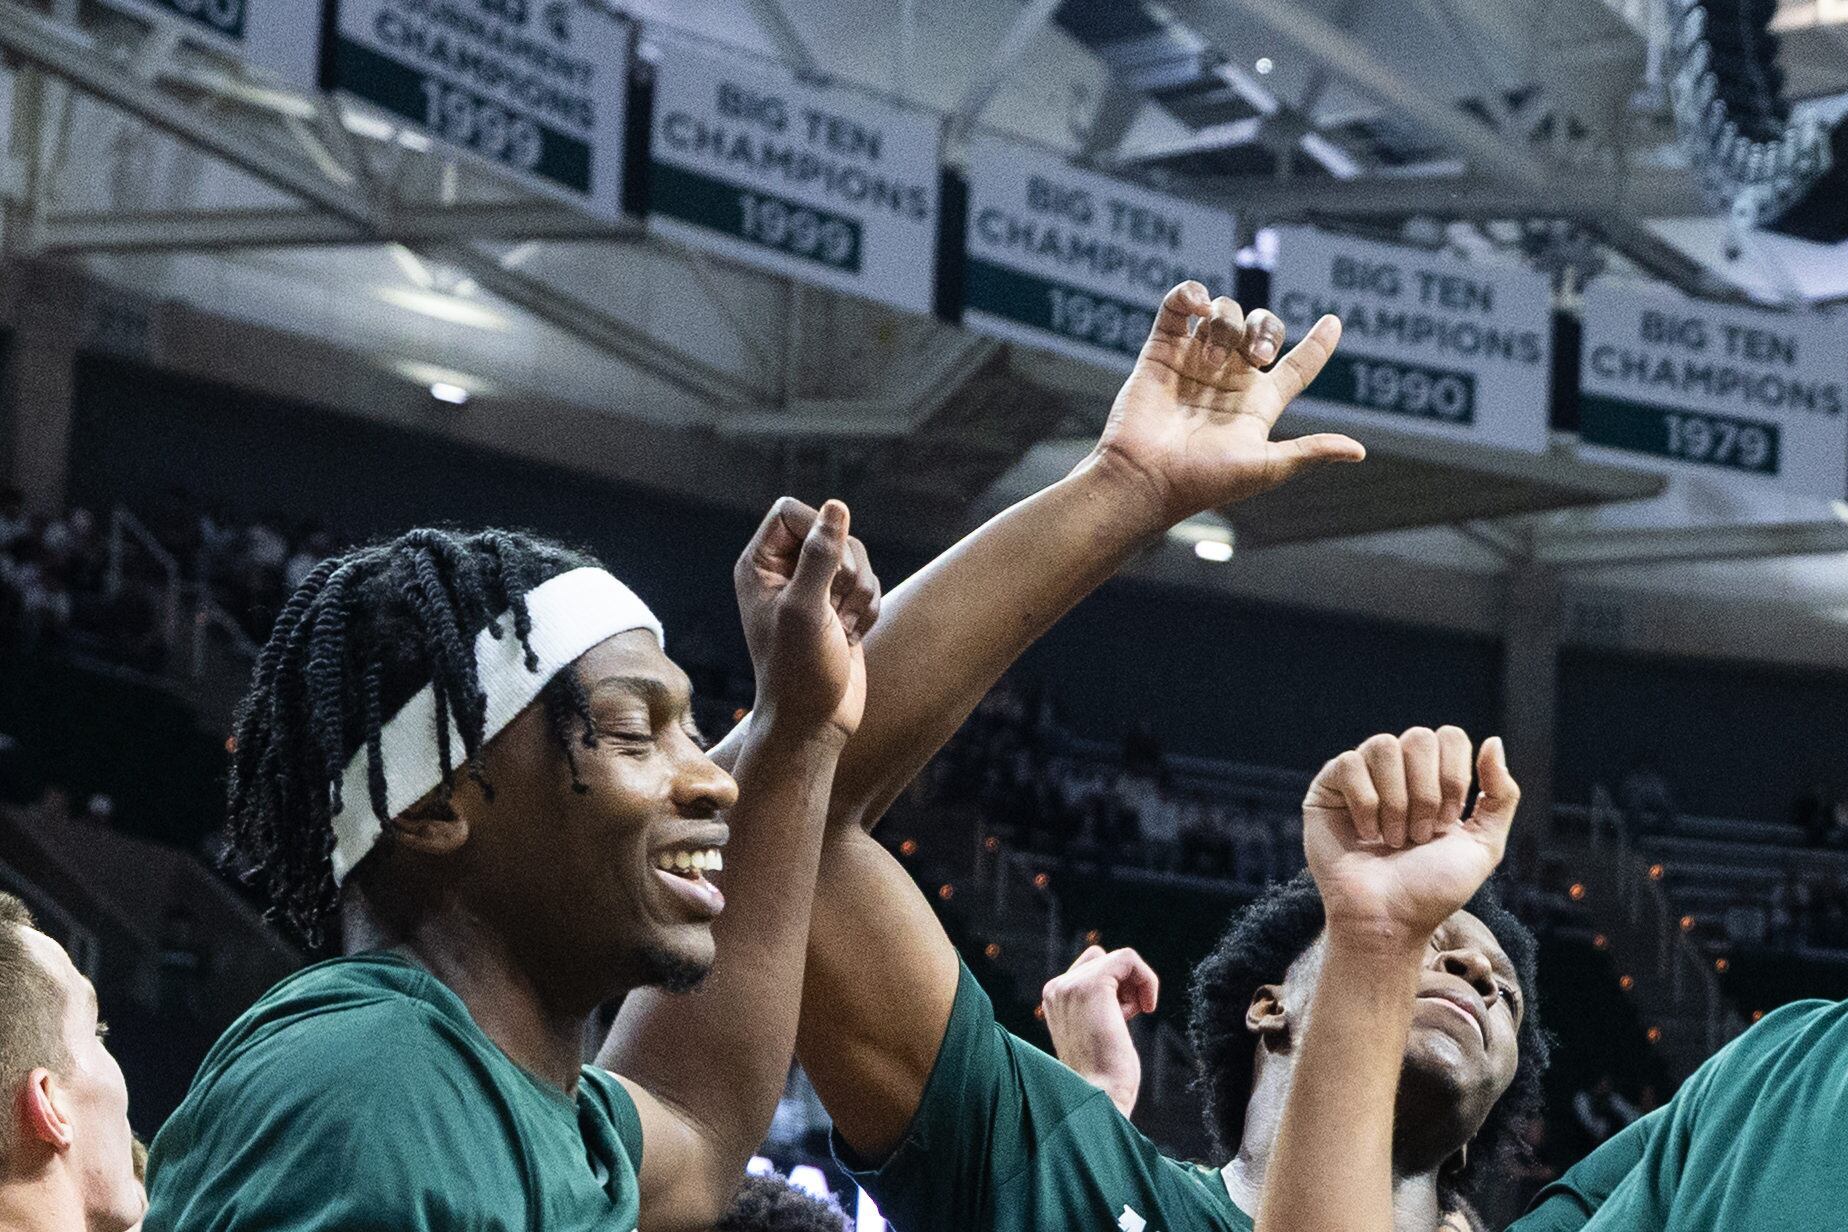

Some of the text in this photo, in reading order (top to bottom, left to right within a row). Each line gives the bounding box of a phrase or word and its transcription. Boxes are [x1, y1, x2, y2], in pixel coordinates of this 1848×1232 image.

[375, 8, 596, 130] CHAMPIONS
[716, 81, 884, 161] BIG TEN
[661, 111, 930, 223] CHAMPIONS
[1025, 174, 1185, 250] BIG TEN
[1331, 254, 1494, 314] BIG TEN
[1642, 311, 1797, 367] BIG TEN
[1352, 360, 1468, 416] 1990
[1591, 345, 1842, 417] CHAMPIONS
[1664, 412, 1770, 467] 1979
